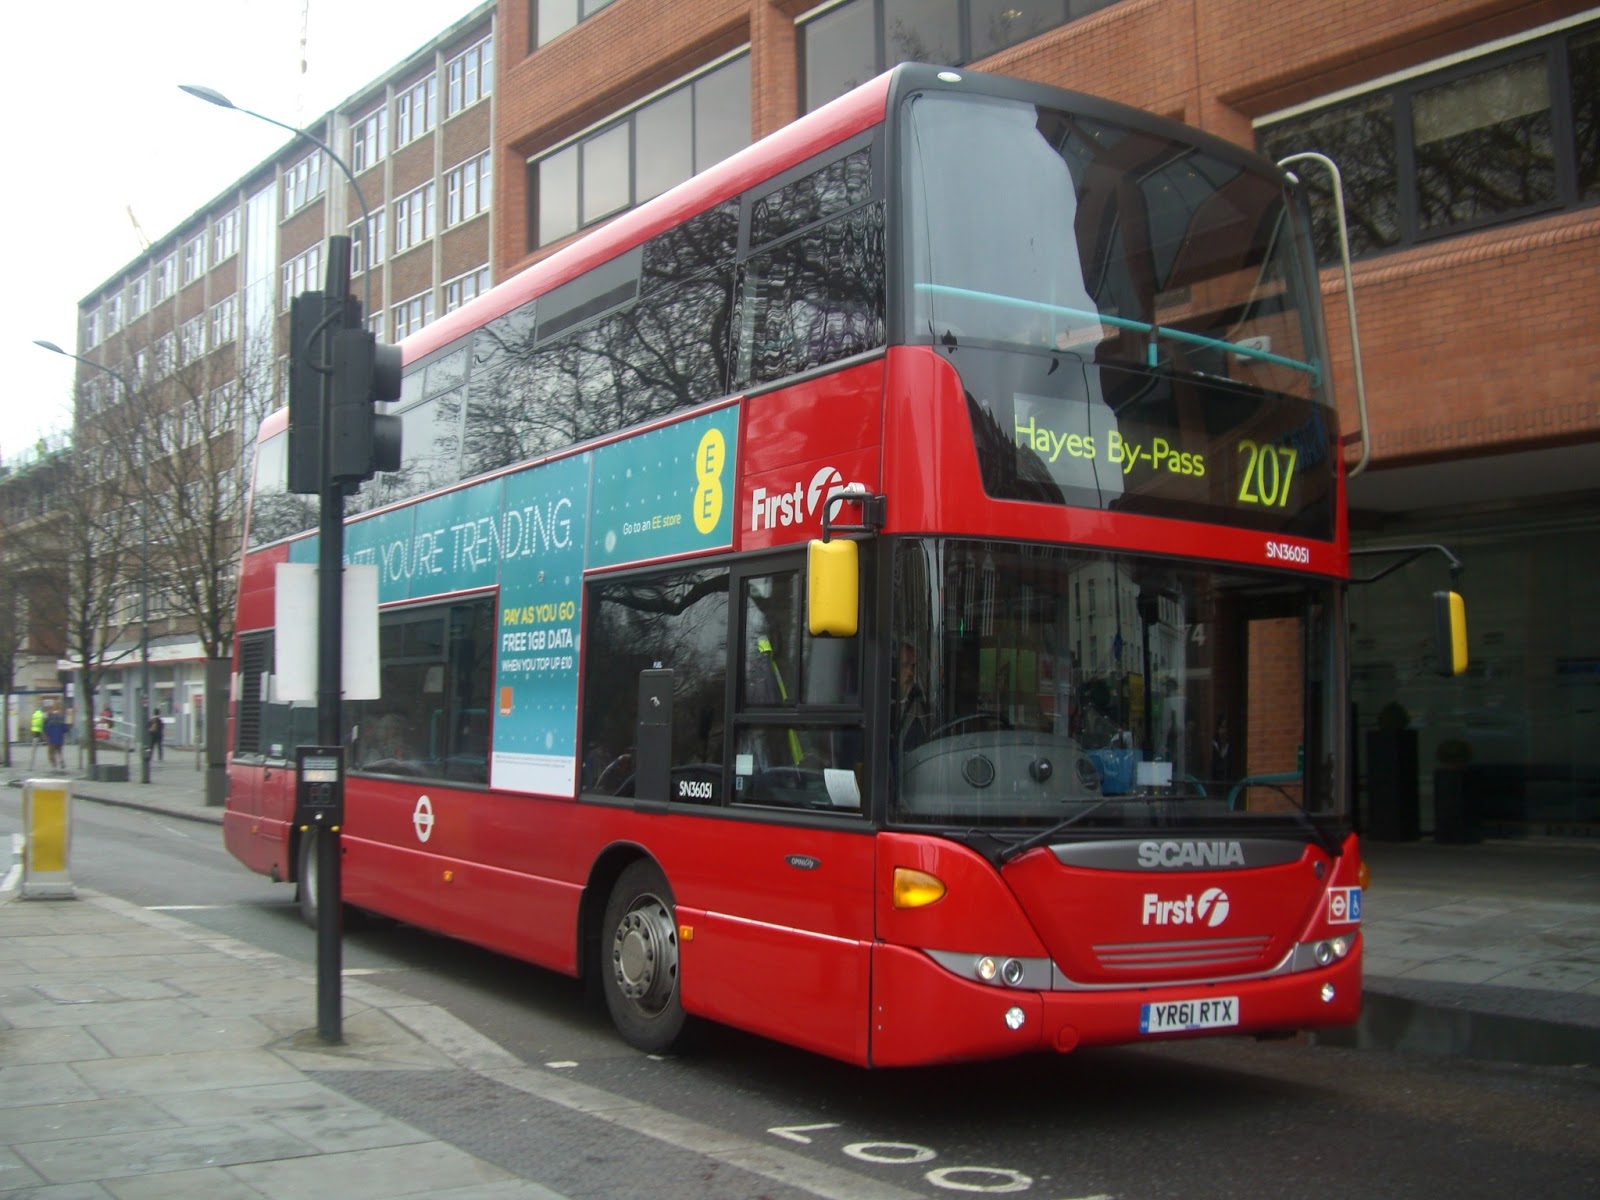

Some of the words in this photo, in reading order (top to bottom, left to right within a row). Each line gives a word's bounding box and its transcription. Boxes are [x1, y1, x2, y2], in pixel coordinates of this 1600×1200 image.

[1015, 415, 1096, 462] Hayes
[1108, 430, 1205, 475] By-Pass
[1238, 439, 1297, 507] 207
[752, 481, 804, 532] First
[623, 522, 633, 535] Go
[633, 522, 642, 533] to
[642, 520, 651, 532] an
[652, 515, 662, 529] EE
[662, 513, 682, 528] store
[1265, 541, 1310, 563] SN36051
[503, 607, 522, 626] PAY
[521, 606, 535, 625] AS
[535, 603, 558, 623] YOU
[558, 601, 575, 621] GO
[502, 632, 527, 652] FREE
[528, 630, 546, 651] 1GB
[547, 628, 574, 649] DATA
[501, 659, 522, 672] WHEN
[521, 658, 537, 671] YOU
[536, 657, 550, 671] TOP
[550, 657, 561, 670] UP
[679, 781, 713, 799] SN36051
[1138, 842, 1245, 868] SCANIA
[1142, 893, 1195, 925] First
[1156, 1003, 1194, 1027] YR61
[1199, 1000, 1233, 1023] RTX
